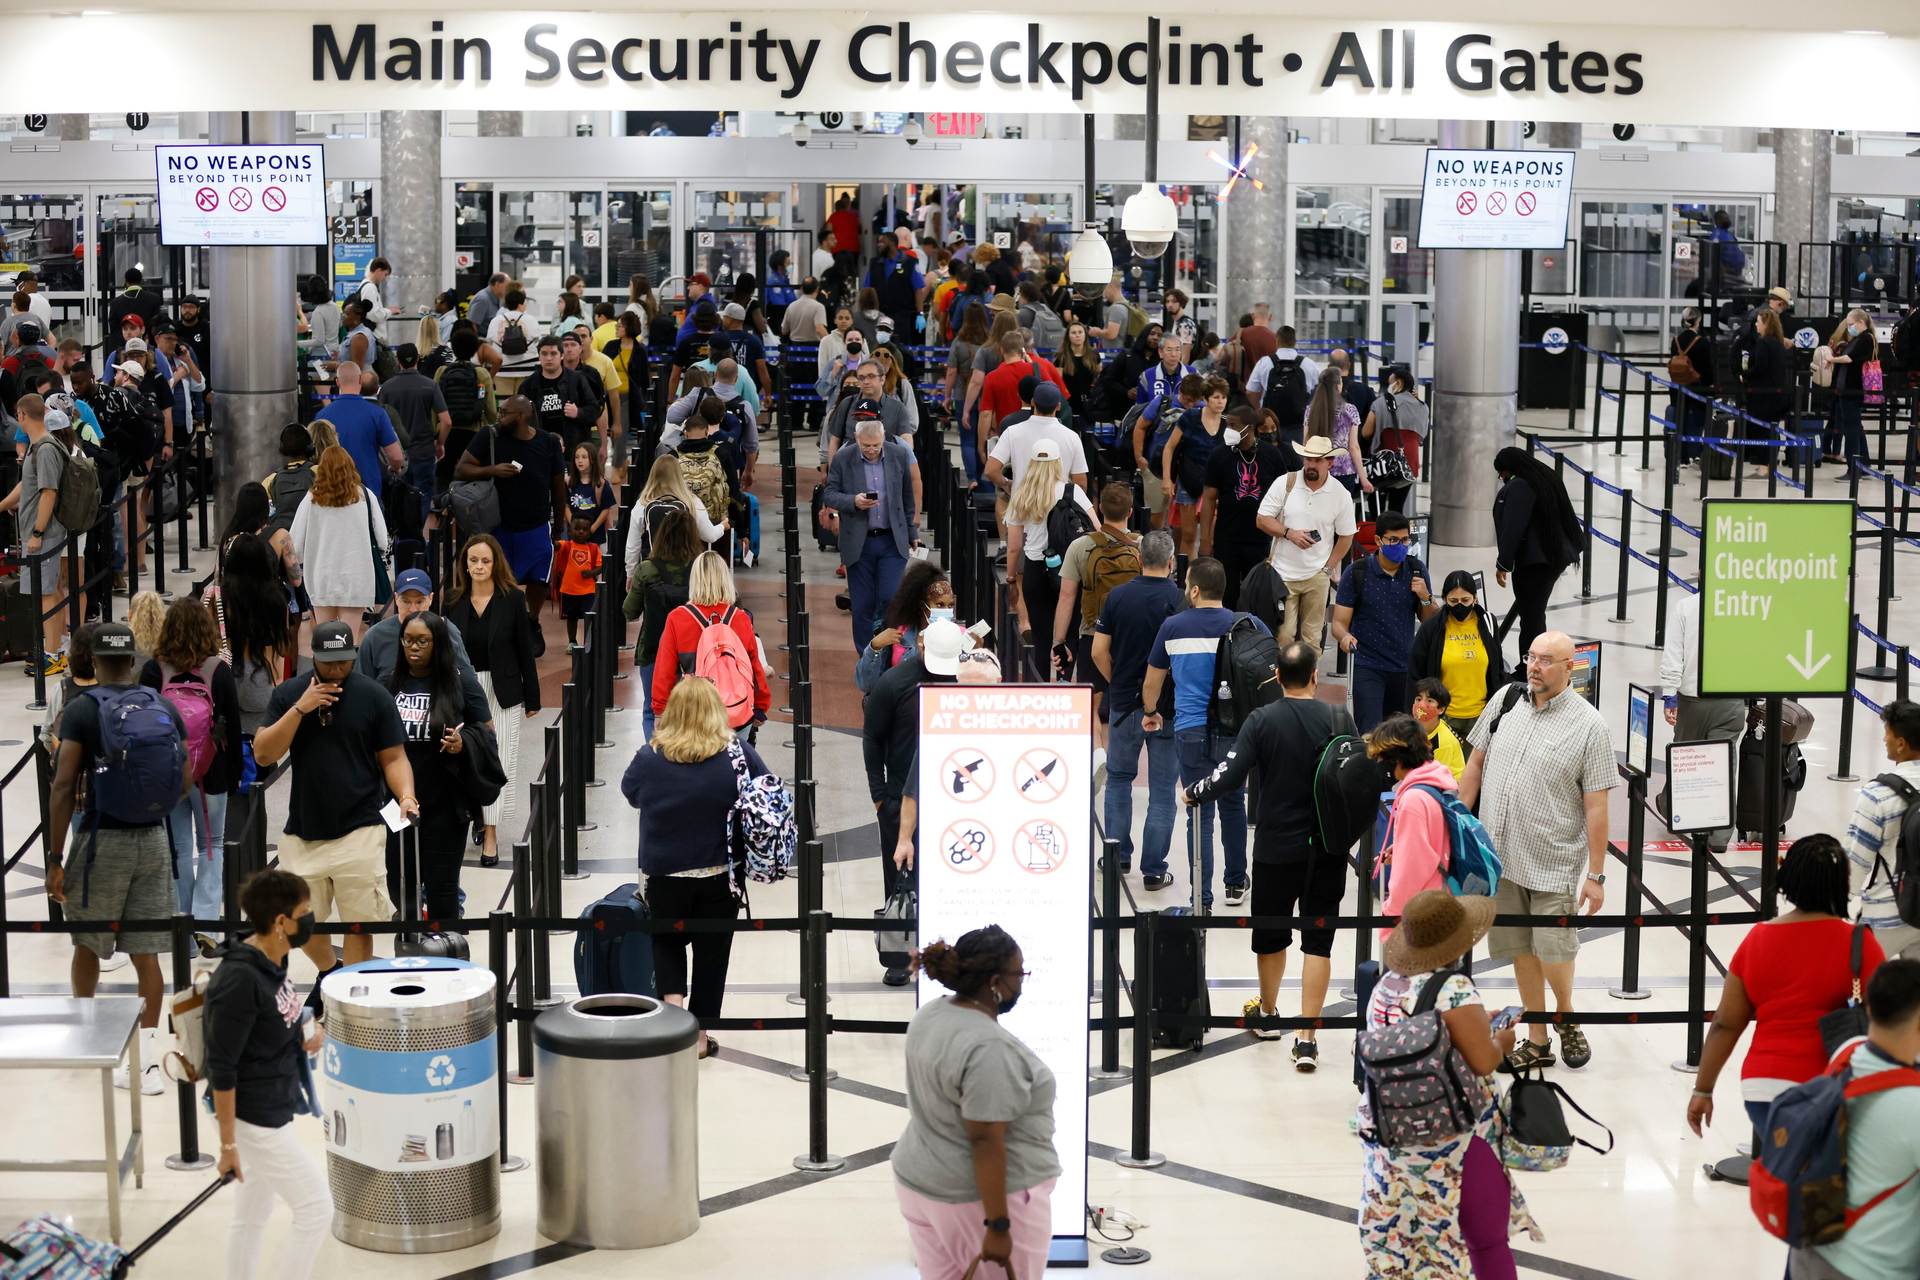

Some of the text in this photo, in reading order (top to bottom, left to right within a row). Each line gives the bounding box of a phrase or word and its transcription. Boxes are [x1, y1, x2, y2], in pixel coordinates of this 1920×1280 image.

[312, 20, 1644, 100] Main Security Checkpoint All Gates
[27, 114, 44, 128] 12
[131, 113, 144, 127] 11
[823, 112, 841, 125] 10
[936, 113, 976, 135] EXIT
[168, 155, 312, 170] NO WEAPONS
[1437, 159, 1564, 176] NO WEAPONS
[169, 173, 312, 183] BEYOND THIS POINT
[1435, 178, 1563, 188] BEYOND THIS POINT
[334, 216, 375, 238] 3-1-1
[541, 404, 562, 412] ATLAN
[1715, 515, 1767, 543] Main
[1714, 552, 1838, 584] Checkpoint
[1714, 589, 1772, 621] Entry
[323, 640, 344, 649] PUMA
[1449, 633, 1480, 641] BALMAI
[939, 694, 1073, 711] NO WEAPONS
[929, 713, 1082, 729] AT CHECKPOINT
